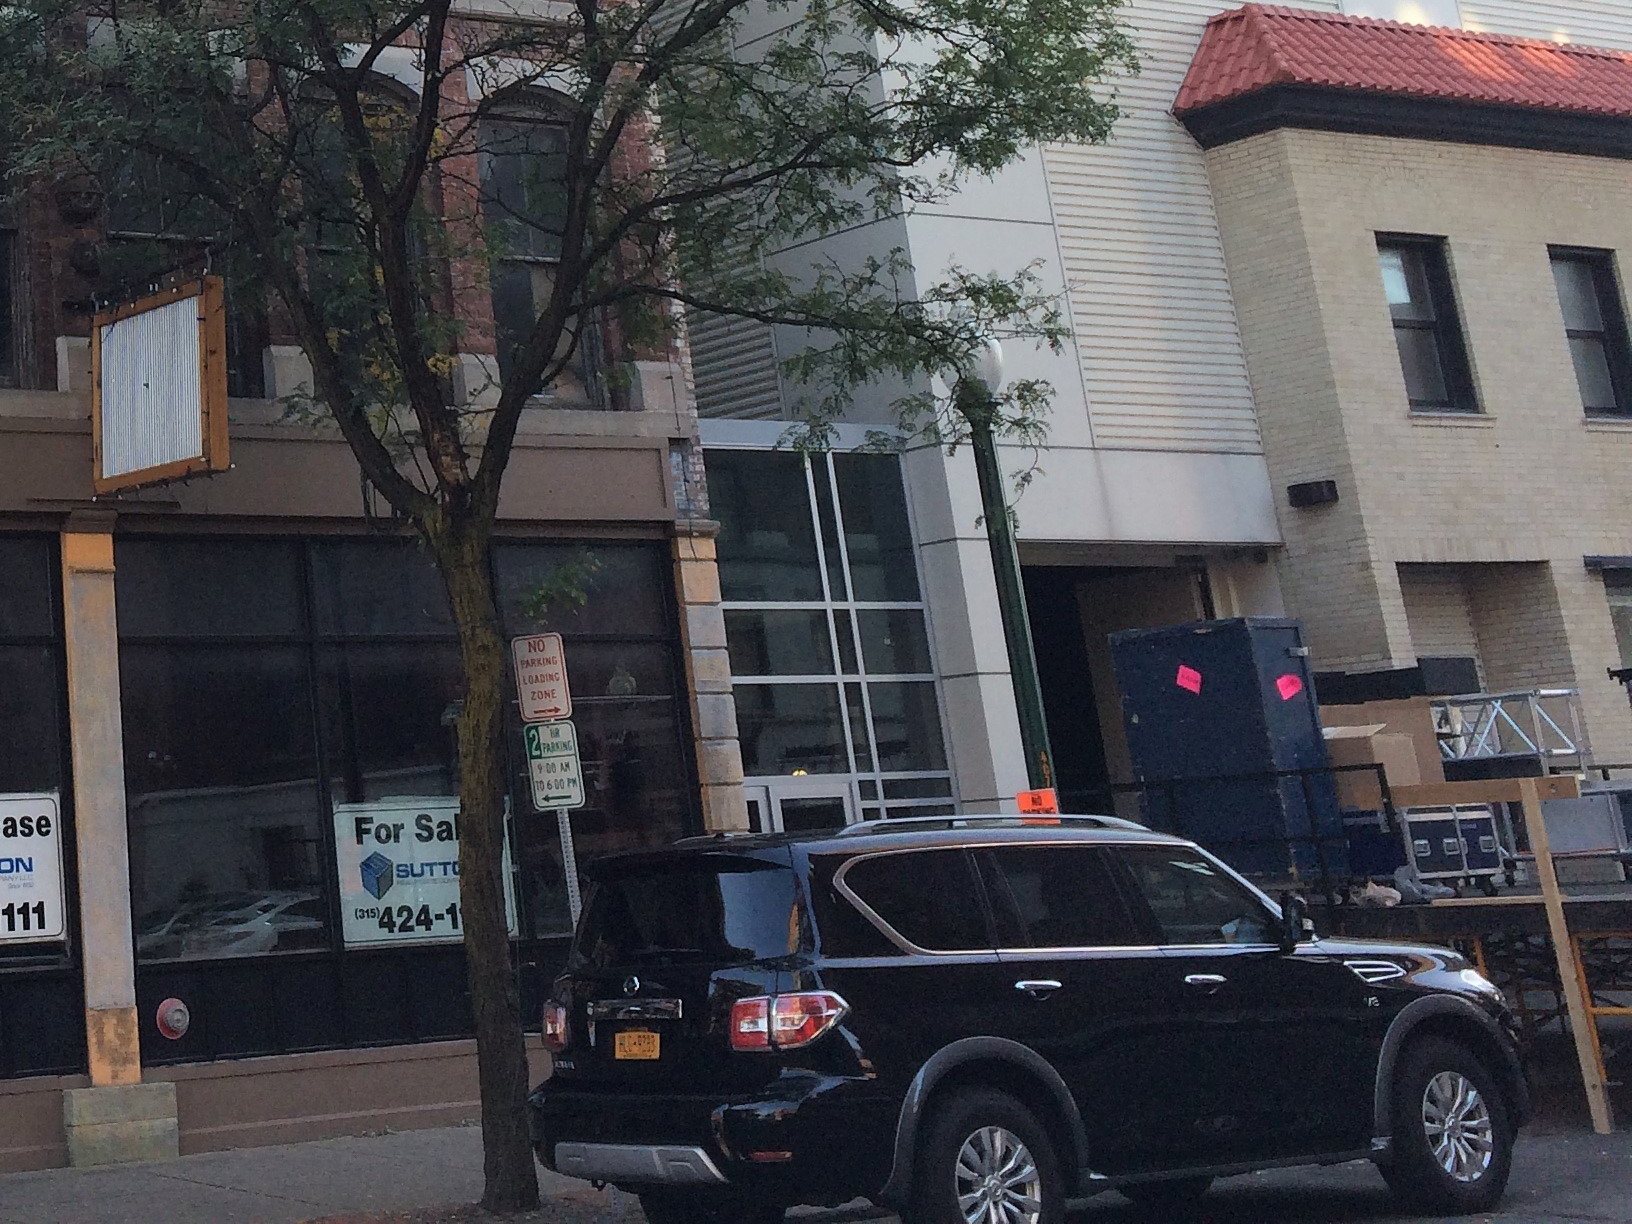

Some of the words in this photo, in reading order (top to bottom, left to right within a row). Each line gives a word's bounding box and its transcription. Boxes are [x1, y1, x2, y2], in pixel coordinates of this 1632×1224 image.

[528, 639, 546, 653] NO
[520, 656, 558, 669] PARKING
[522, 672, 560, 685] LOADING
[530, 689, 557, 701] ZONE
[529, 729, 541, 756] 2
[542, 740, 573, 754] PARKING
[560, 761, 571, 773] AM
[536, 780, 545, 791] TO
[355, 816, 404, 845] For
[415, 813, 461, 843] Sal
[396, 861, 460, 879] SUTT
[355, 907, 381, 921] (315)
[378, 902, 462, 934] 424-1
